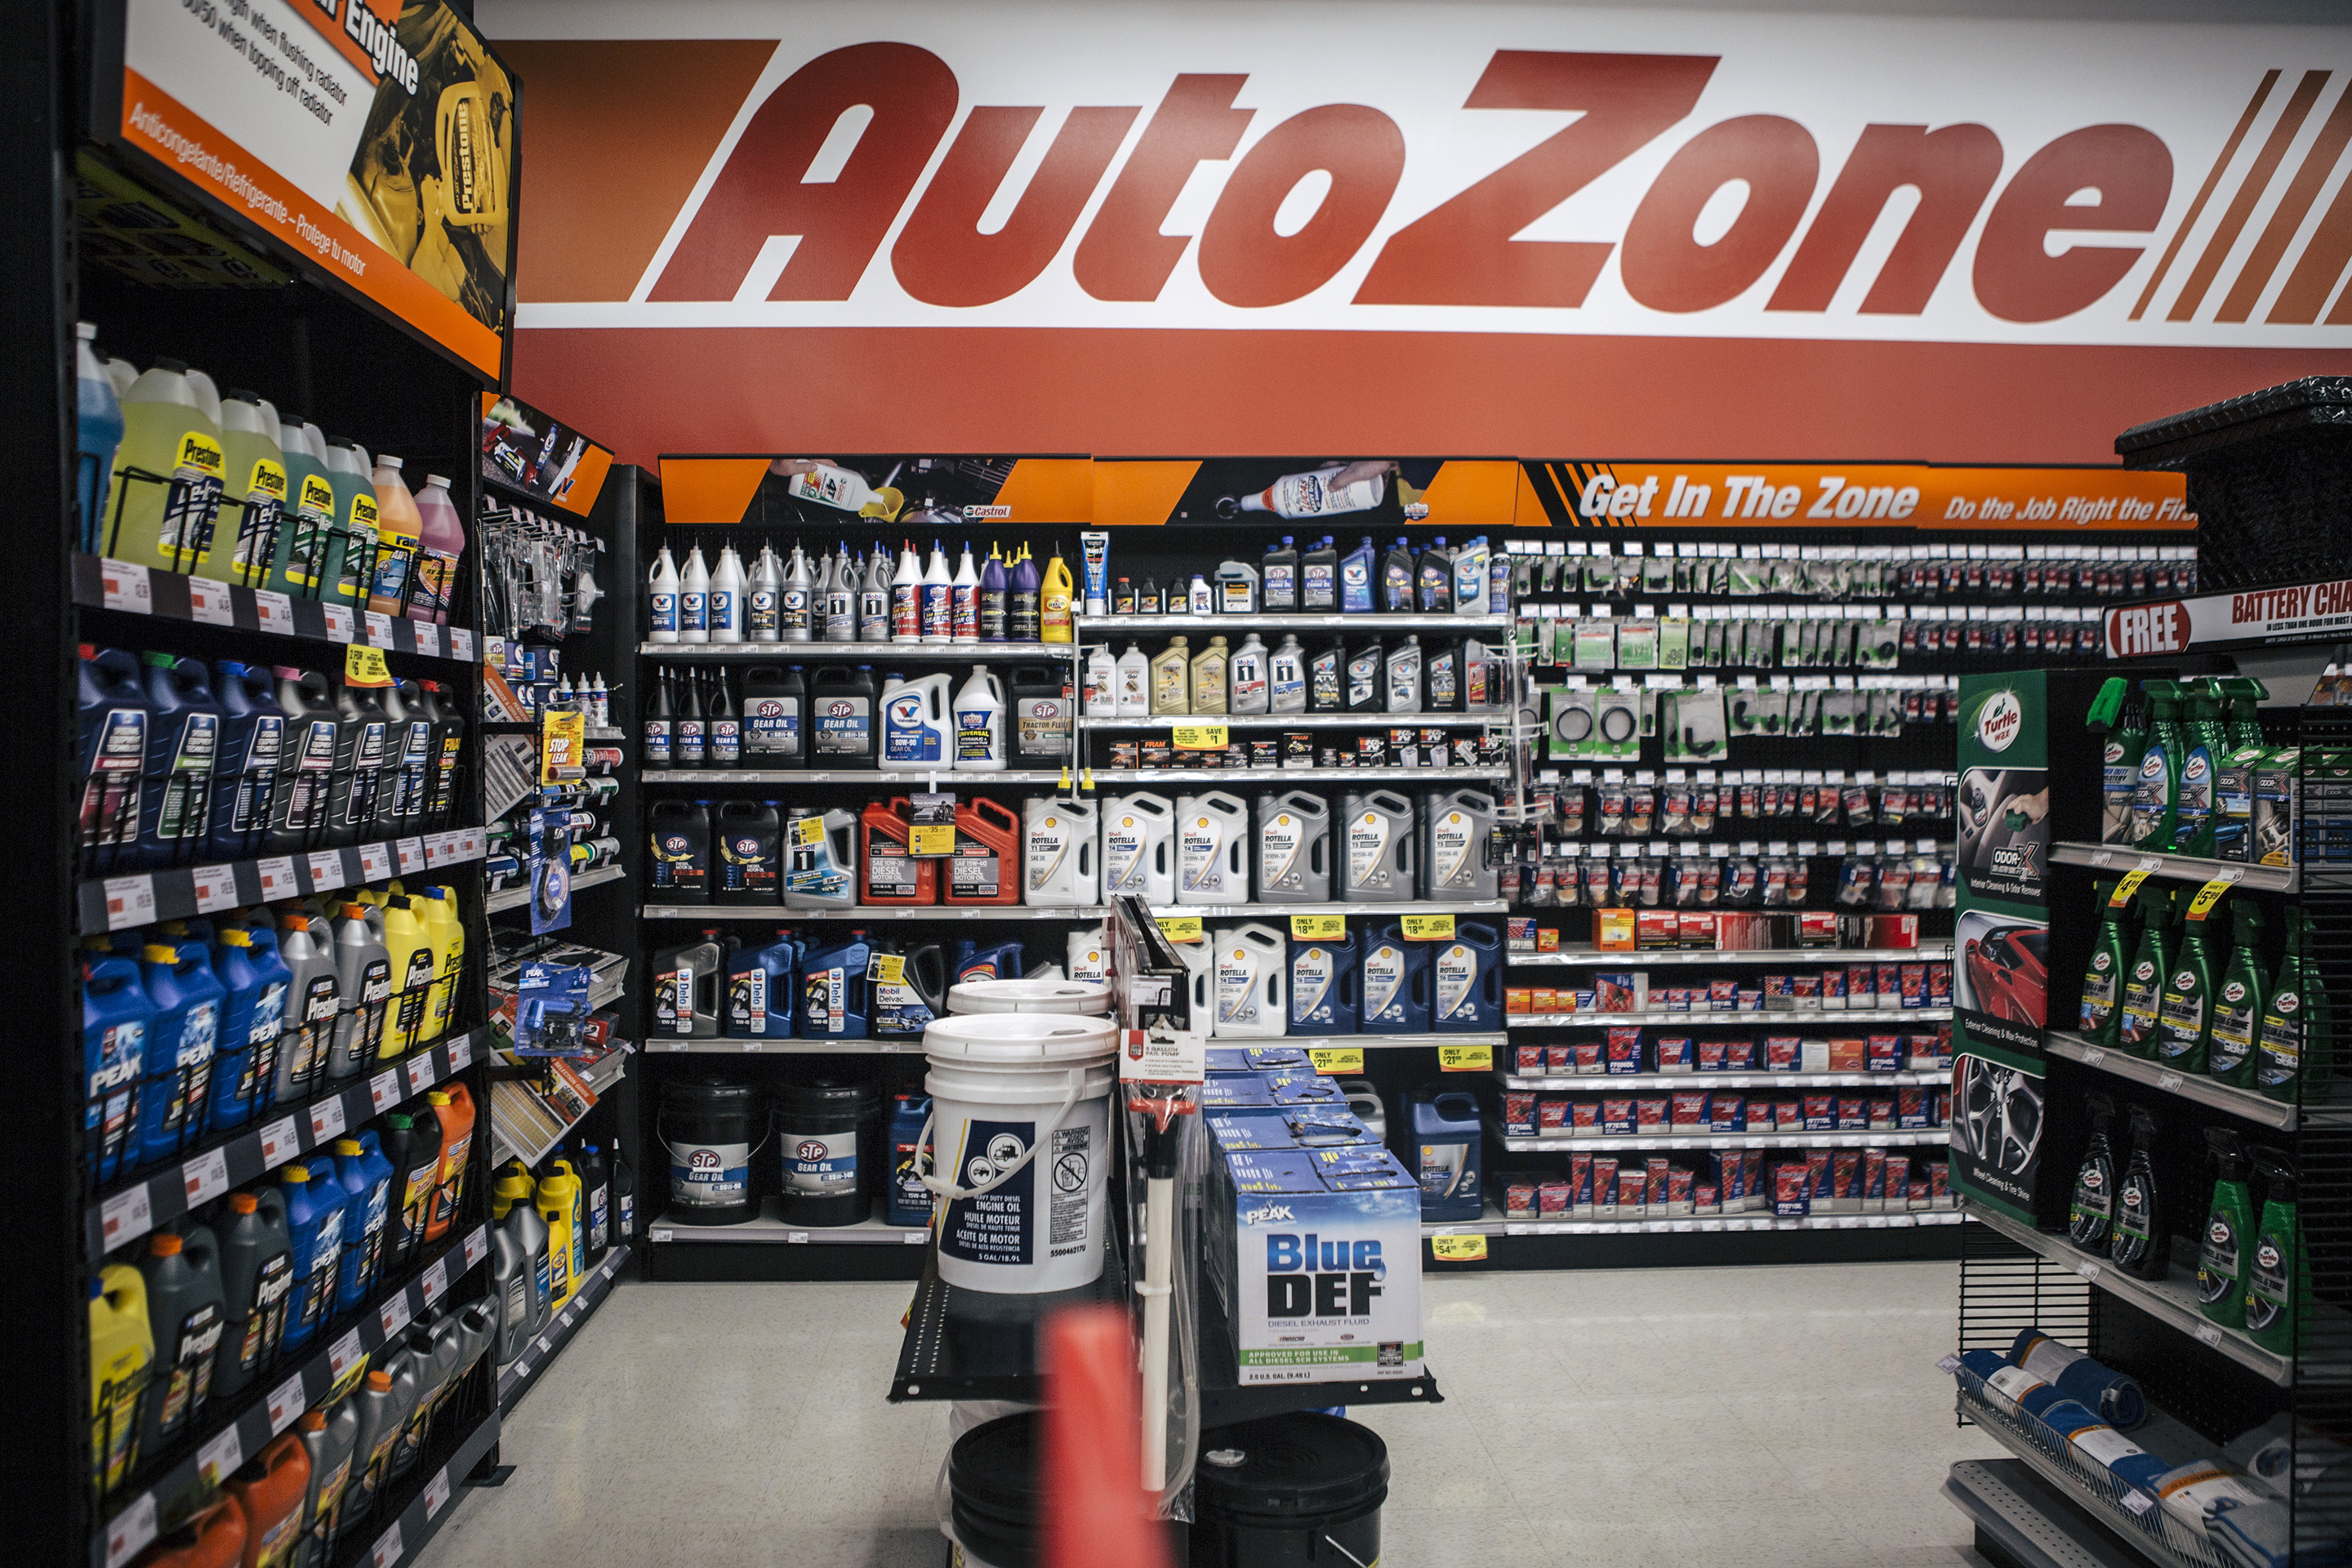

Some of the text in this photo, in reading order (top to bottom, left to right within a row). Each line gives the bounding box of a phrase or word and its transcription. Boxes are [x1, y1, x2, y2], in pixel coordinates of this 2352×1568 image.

[345, 0, 418, 95] Engine
[251, 10, 277, 47] when
[279, 31, 314, 82] flushing
[315, 67, 348, 107] radiator
[218, 18, 246, 56] when
[248, 42, 285, 91] topping
[286, 74, 301, 100] off
[299, 87, 333, 127] radiator
[458, 101, 474, 210] Prestone
[128, 101, 366, 277] Anticongelante/Refrigerante Protege tu motor
[647, 40, 2175, 324] AutoZone
[184, 439, 221, 469] Prestone
[256, 465, 285, 492] Prestone
[306, 480, 332, 506] Prestone
[1579, 473, 1921, 520] Get In The Zone
[354, 498, 379, 528] Prestone
[974, 506, 1009, 517] Castrol
[1944, 496, 1976, 520] Do
[1978, 496, 2015, 521] the
[2016, 496, 2058, 521] Job
[2058, 496, 2118, 526] Right
[2118, 496, 2155, 522] the
[1271, 569, 1288, 578] STP
[1310, 569, 1327, 578] STP
[2120, 604, 2180, 655] FREE
[2231, 586, 2312, 625] BATTERY
[2272, 621, 2284, 631] LESS
[2284, 620, 2297, 630] THAN
[2298, 619, 2309, 629] ONE
[2309, 618, 2323, 629] HOUR
[2323, 618, 2333, 627] FOR
[2334, 616, 2350, 626] MOST
[760, 704, 782, 716] STP
[831, 704, 853, 716] STP
[1035, 704, 1056, 716] STP
[683, 724, 698, 735] STP
[753, 719, 788, 728] GEAR OIL
[824, 719, 859, 728] GEAR OIL
[1984, 710, 2018, 736] Turtle
[958, 729, 990, 737] UNIVERSAL
[1206, 728, 1223, 736] SAVE
[1993, 728, 2011, 743] wax
[548, 738, 570, 753] STOP
[550, 753, 569, 764] LEAK
[1108, 836, 1136, 844] ROTELLA
[1184, 837, 1211, 845] ROTELLA
[1352, 833, 1379, 841] ROTELLA
[669, 839, 686, 851] STP
[739, 841, 756, 853] STP
[872, 866, 902, 875] DIESEL
[954, 866, 983, 876] DIESEL
[1970, 877, 1986, 890] Interior
[1985, 879, 2005, 894] Cleaning
[2010, 883, 2020, 894] Odor
[2021, 884, 2042, 898] Remover
[679, 982, 690, 1005] Delo
[752, 982, 764, 1005] Delo
[830, 982, 842, 1004] Delo
[879, 995, 904, 1003] Delvac
[250, 1018, 283, 1045] PEAK
[176, 1040, 216, 1068] PEAK
[89, 1054, 142, 1098] PEAK
[574, 1082, 590, 1099] GUIDE
[1062, 1129, 1089, 1138] WARNING
[800, 1143, 824, 1159] STP
[693, 1152, 717, 1167] STP
[797, 1162, 832, 1172] GEAR OIL
[688, 1171, 724, 1182] GEAR OIL
[976, 1200, 1021, 1213] ENGINE OIL
[964, 1211, 1021, 1225] HUILE MOTEUR
[1246, 1205, 1295, 1226] PEAK
[956, 1229, 1021, 1245] ACEITE DE MOTOR
[1267, 1233, 1382, 1273] Blue
[1267, 1272, 1382, 1318] DEF
[1267, 1318, 1370, 1328] DIESEL EXHAUST FLUID
[1249, 1350, 1293, 1358] APPROVED
[1266, 1356, 1294, 1365] DIESEL
